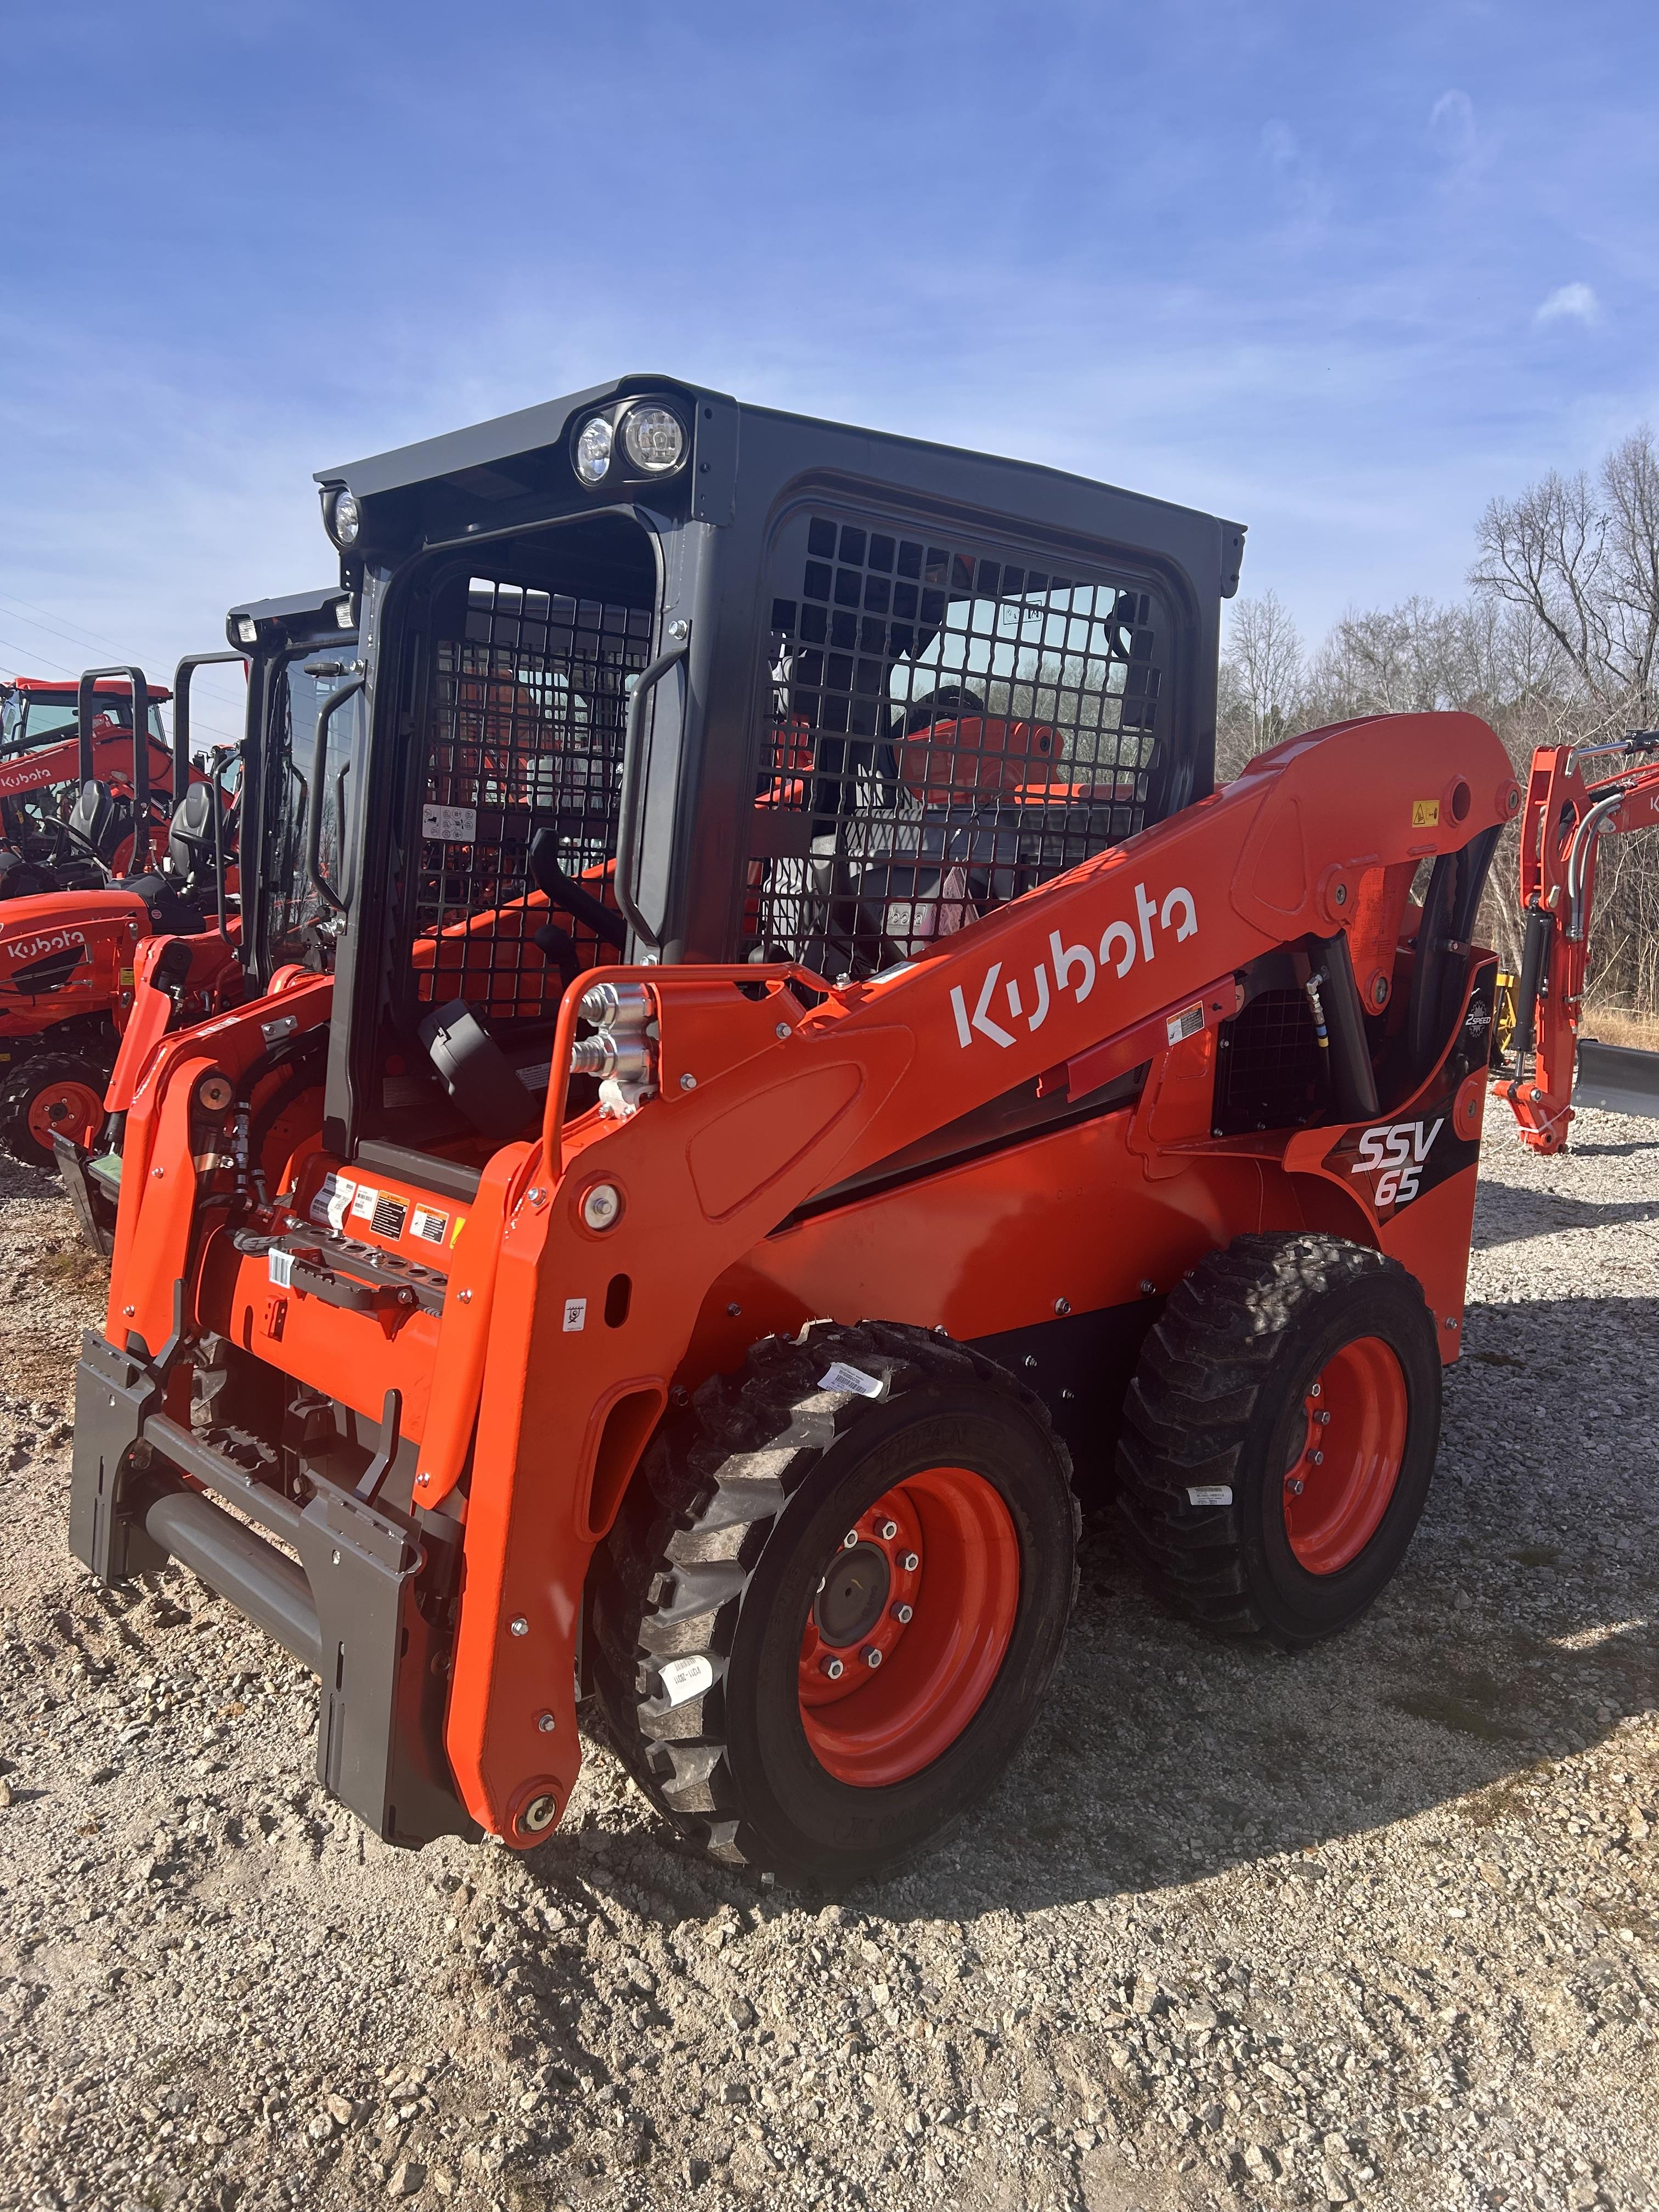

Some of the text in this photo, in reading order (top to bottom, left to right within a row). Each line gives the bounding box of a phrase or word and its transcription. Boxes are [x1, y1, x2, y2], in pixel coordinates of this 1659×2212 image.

[1, 768, 51, 788] Kubota
[7, 930, 85, 958] Kubota
[950, 882, 1199, 1049] Kubota
[1351, 1118, 1445, 1173] SSV
[1374, 1165, 1424, 1206] 65
